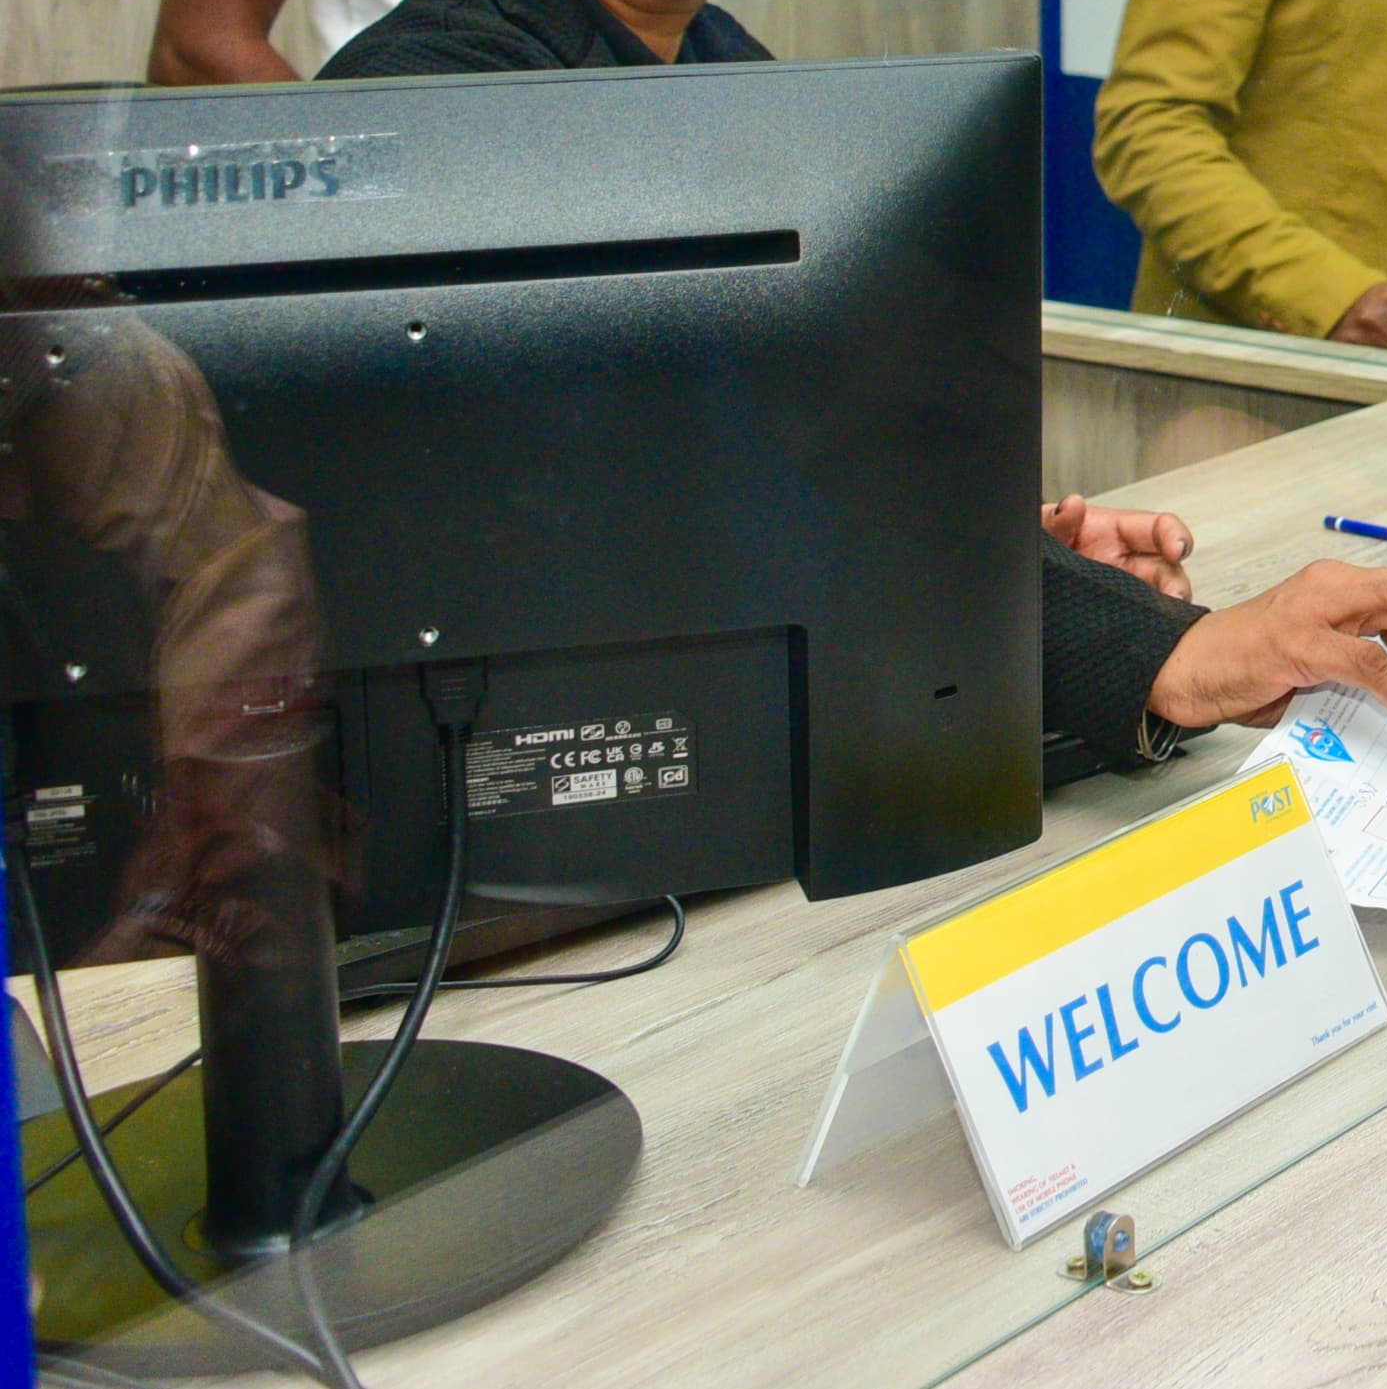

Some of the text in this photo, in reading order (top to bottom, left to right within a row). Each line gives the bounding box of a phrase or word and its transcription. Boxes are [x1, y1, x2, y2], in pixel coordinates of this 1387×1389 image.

[120, 159, 340, 207] PHILIPS
[514, 728, 575, 746] HDMI
[573, 772, 613, 784] SAFETY
[1249, 784, 1291, 823] POST
[986, 879, 1320, 1113] WELCOME
